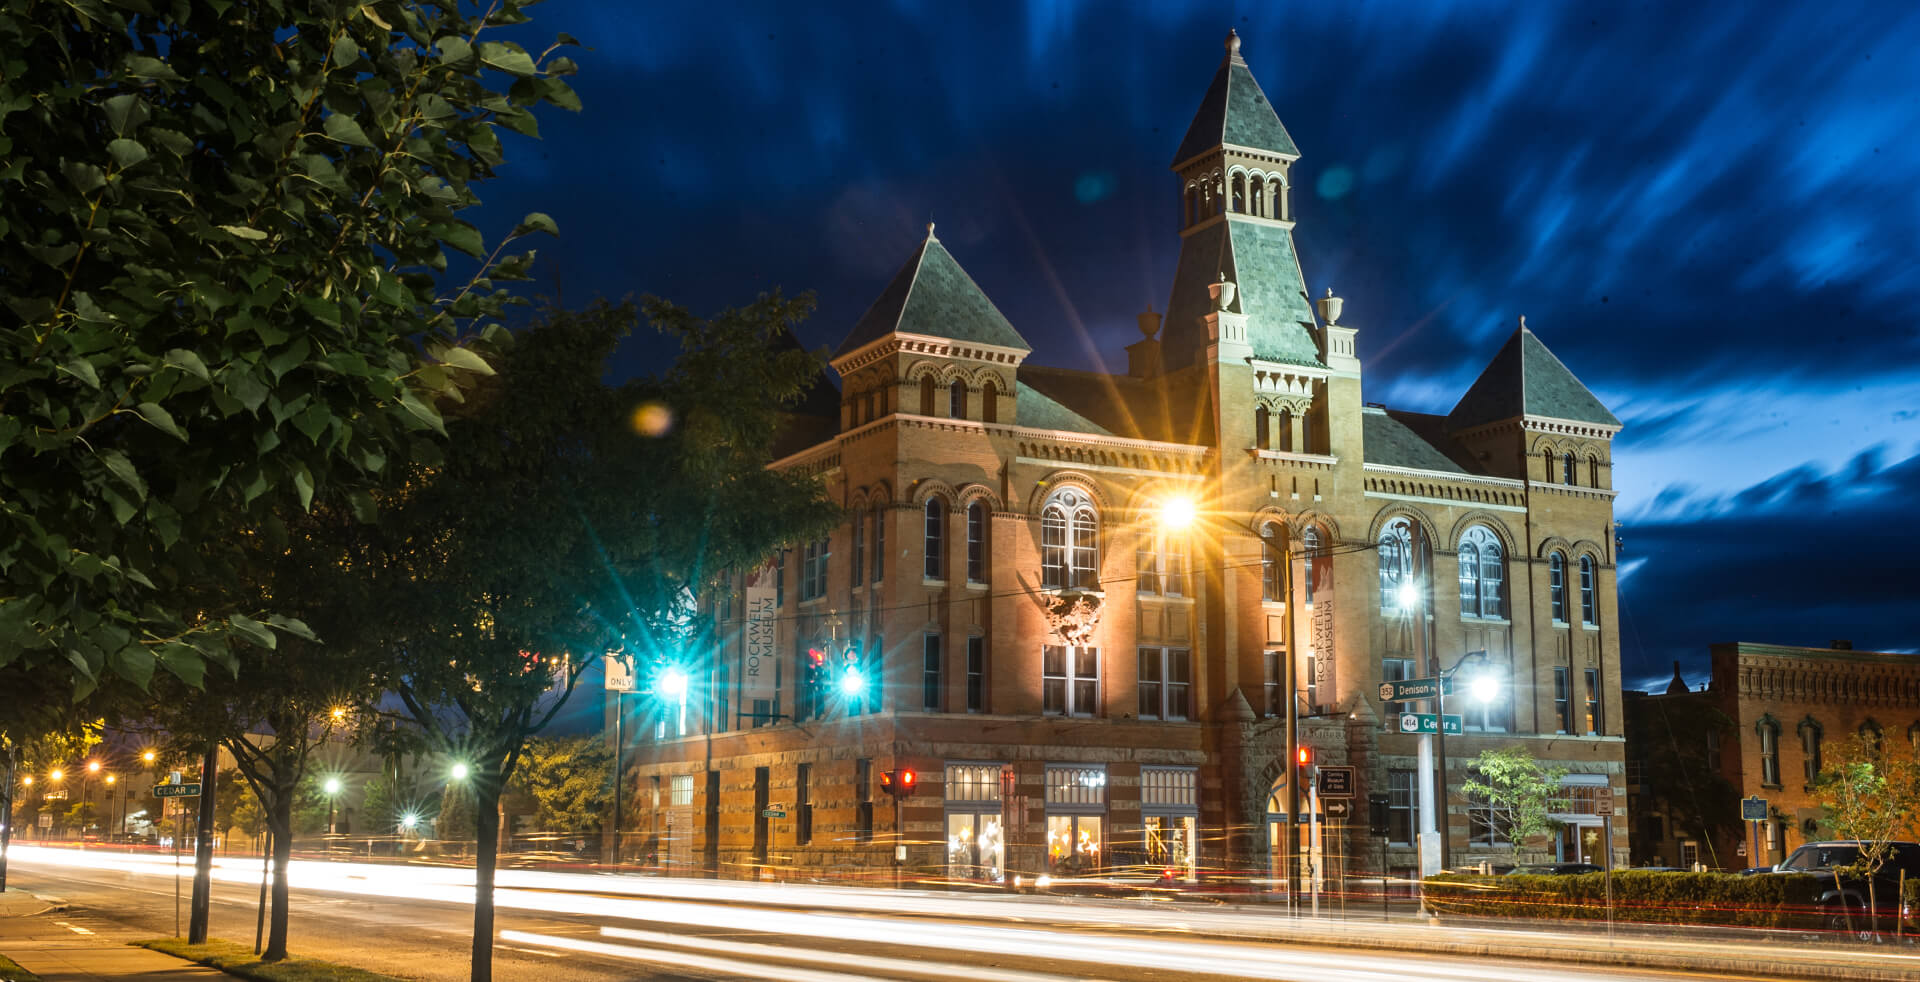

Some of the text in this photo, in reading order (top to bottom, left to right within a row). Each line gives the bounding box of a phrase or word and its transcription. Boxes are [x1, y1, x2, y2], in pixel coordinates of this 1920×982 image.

[748, 597, 761, 677] ROCKWELL
[763, 598, 774, 657] MUSEUM
[1314, 601, 1325, 682] ROCKWELL
[1324, 600, 1334, 661] MUSEUM
[610, 678, 632, 686] ONLY
[1381, 687, 1393, 696] 352
[1399, 685, 1429, 696] Denison
[1404, 719, 1416, 728] 414
[157, 787, 186, 795] CEDAR
